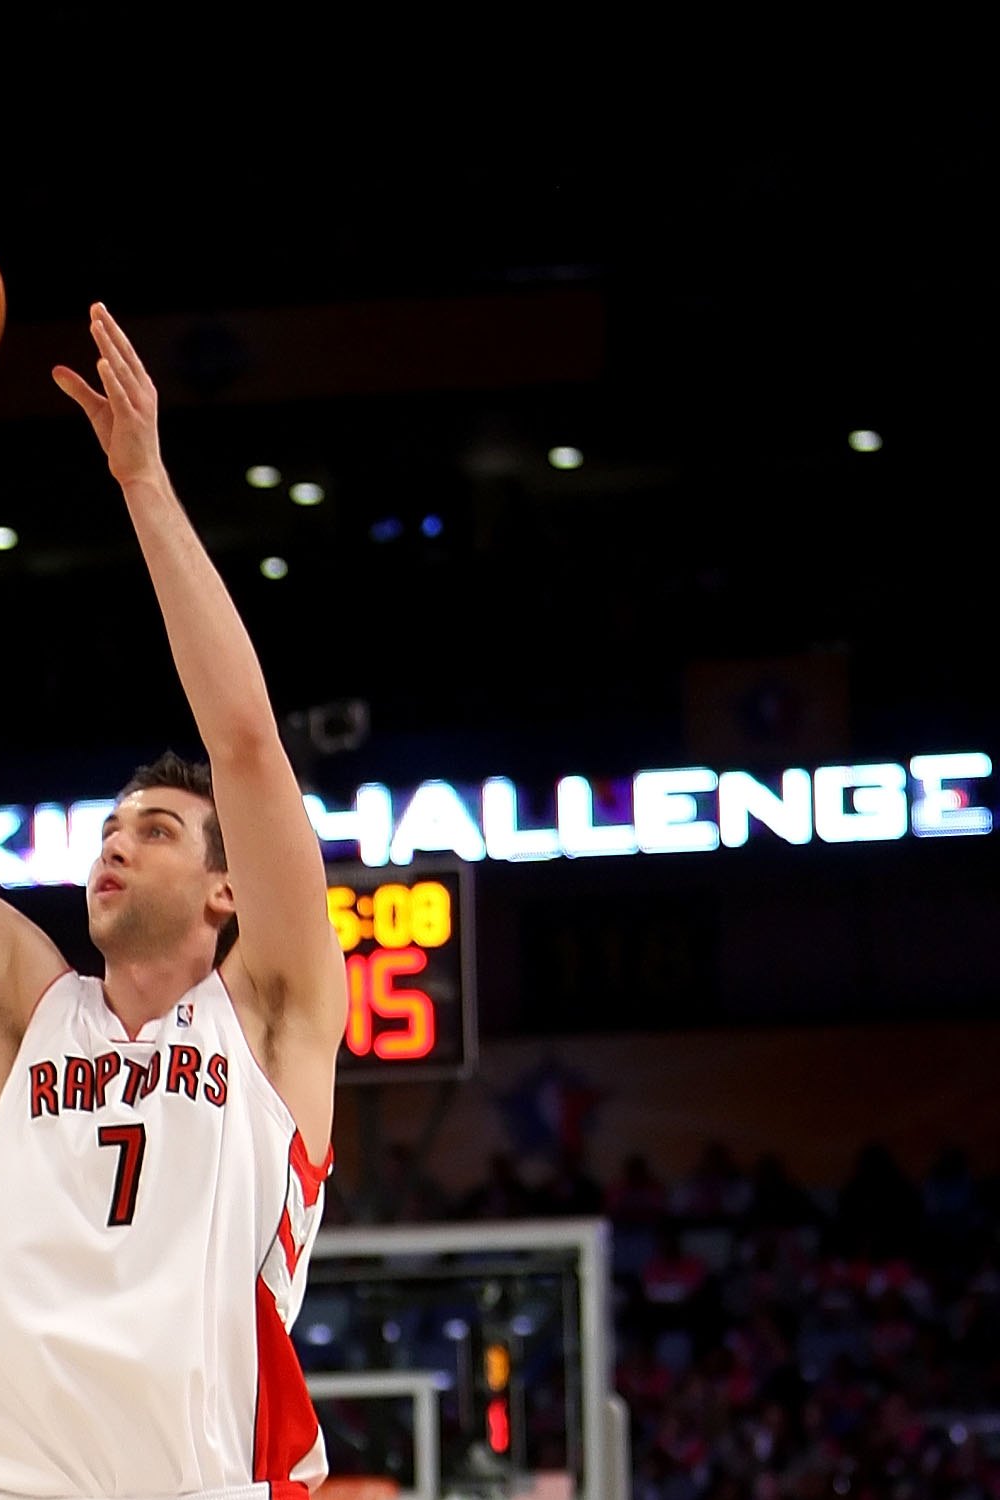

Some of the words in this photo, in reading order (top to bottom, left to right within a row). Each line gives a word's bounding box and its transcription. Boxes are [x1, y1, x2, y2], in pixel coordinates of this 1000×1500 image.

[302, 752, 992, 868] HALLENGE
[346, 947, 435, 1060] 15
[29, 1044, 228, 1119] RAPTORS
[98, 1123, 146, 1227] 7
